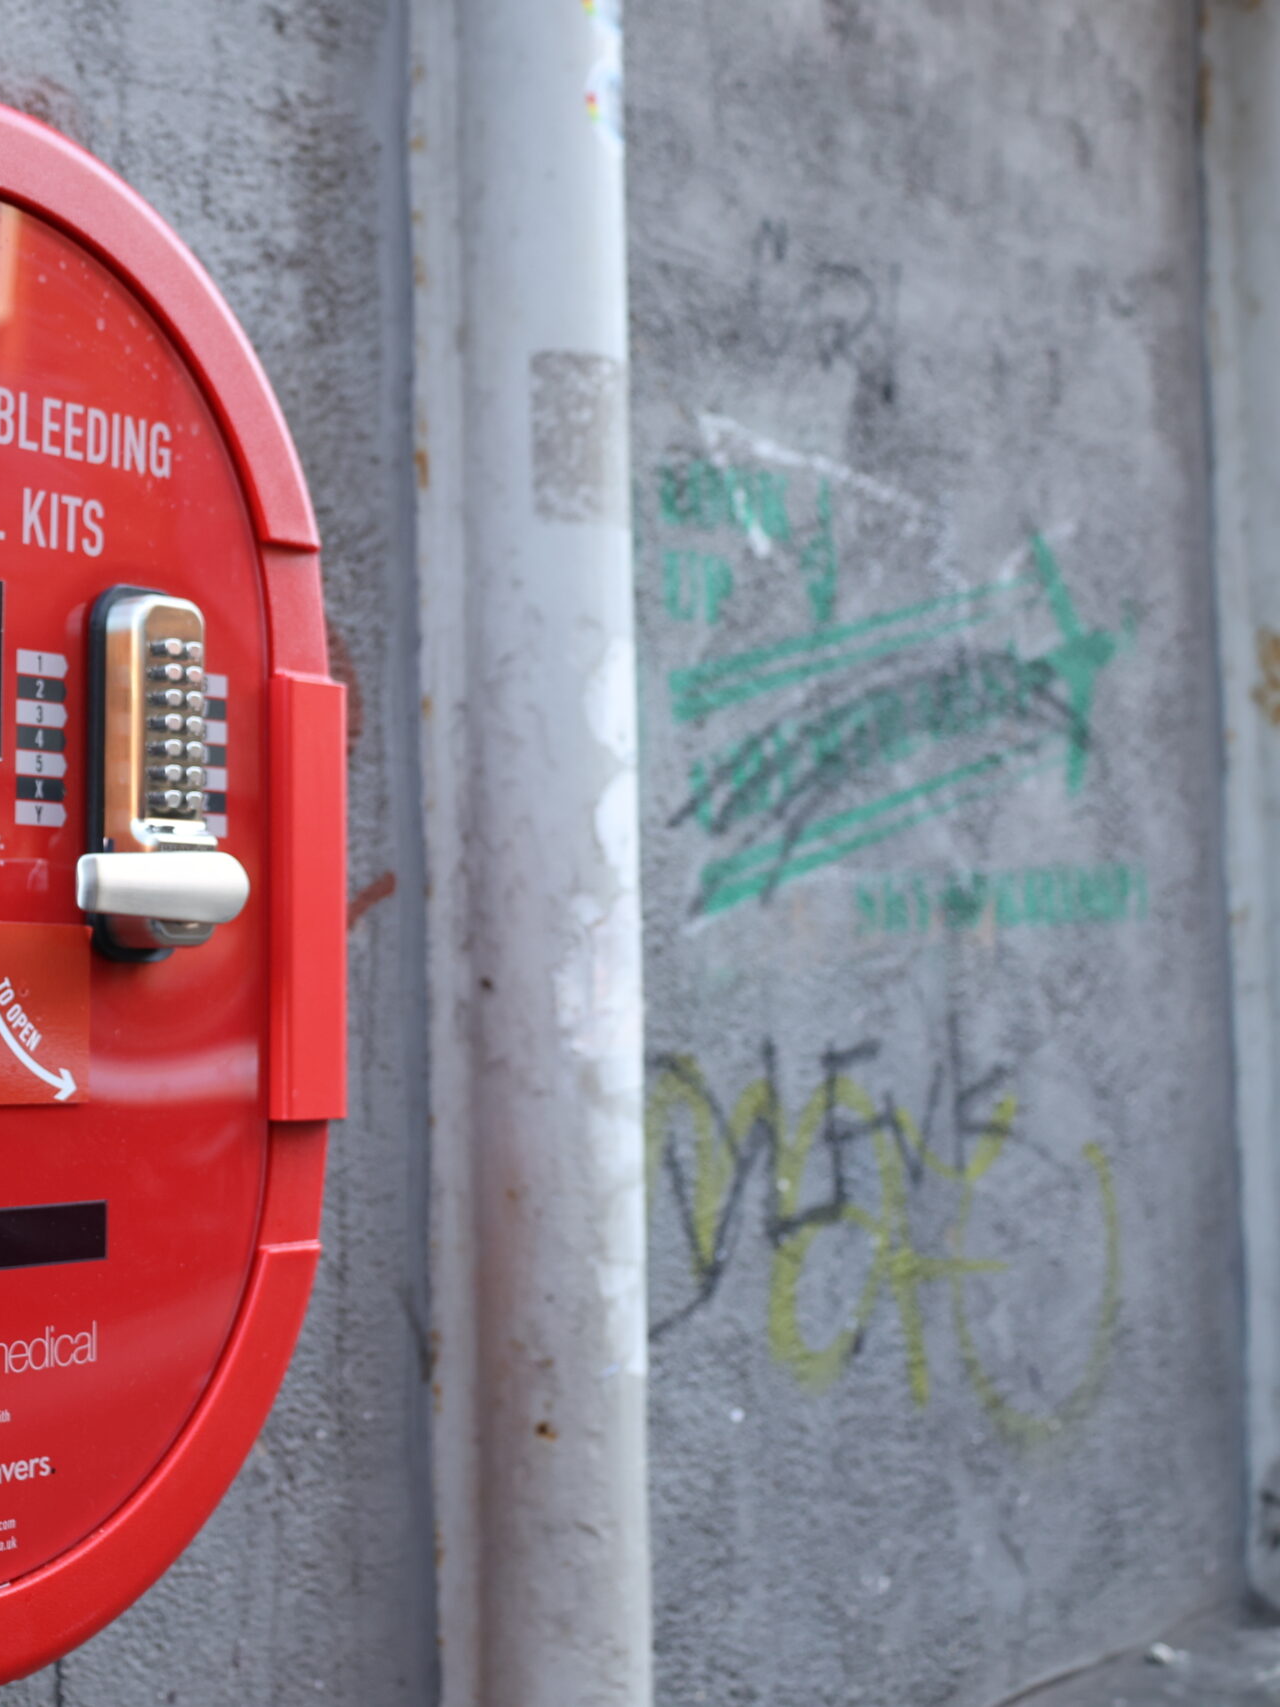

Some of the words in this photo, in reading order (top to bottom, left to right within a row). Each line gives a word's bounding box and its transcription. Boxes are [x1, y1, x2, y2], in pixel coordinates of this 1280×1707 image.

[21, 487, 105, 557] KITS
[35, 654, 43, 671] 1
[35, 679, 45, 699] 2
[35, 705, 44, 723] 3
[35, 729, 45, 747] 4
[35, 754, 44, 772] 5
[34, 780, 45, 799] X
[34, 806, 43, 824] Y
[6, 1003, 43, 1052] OPEN
